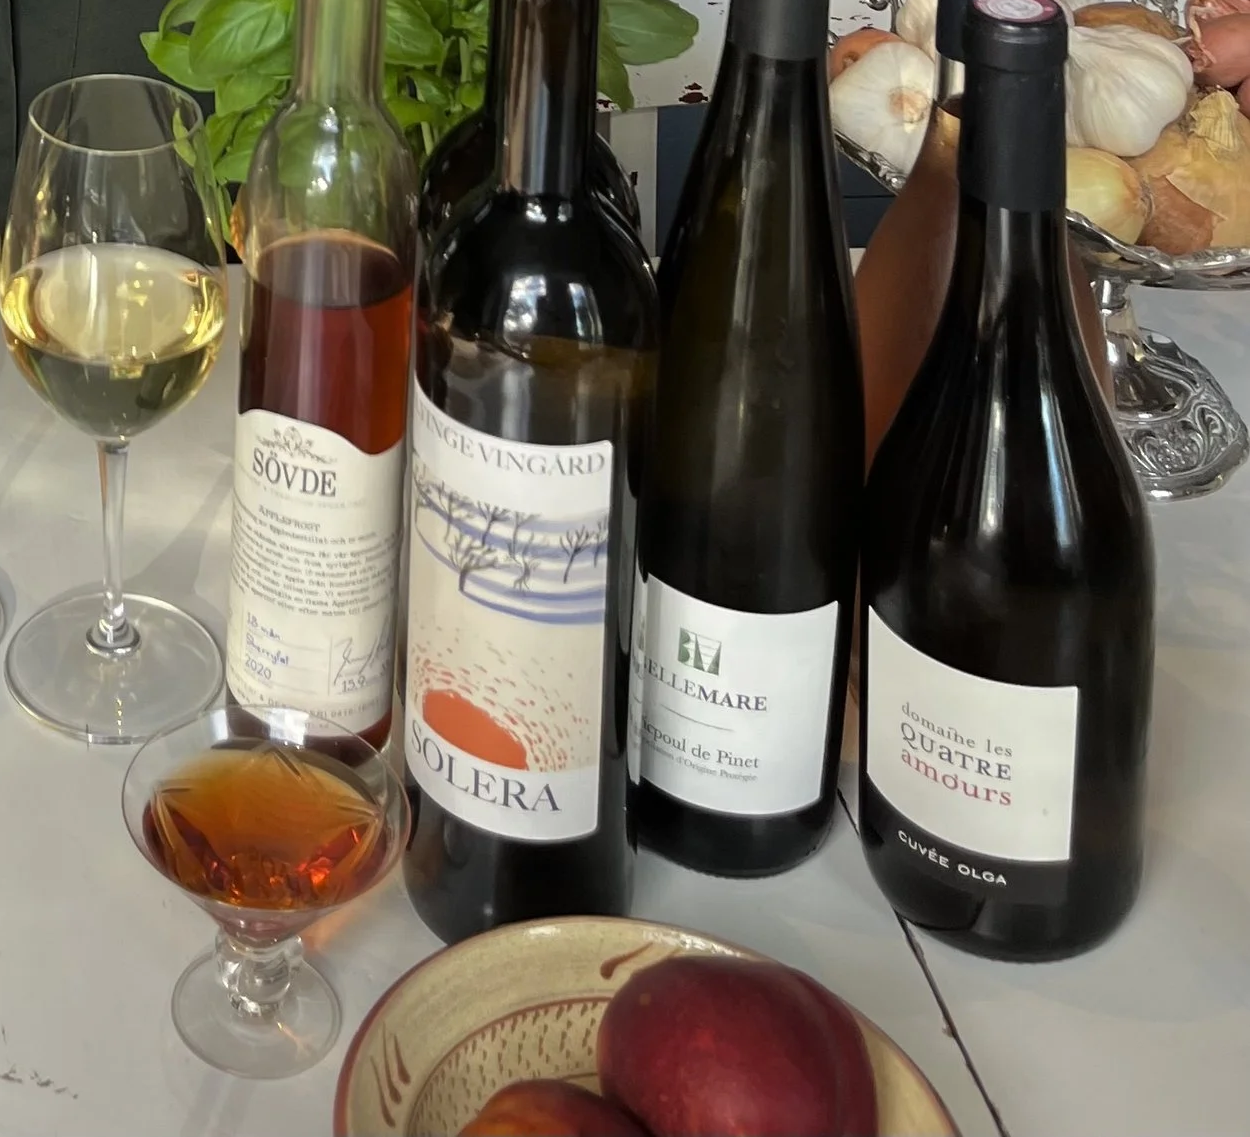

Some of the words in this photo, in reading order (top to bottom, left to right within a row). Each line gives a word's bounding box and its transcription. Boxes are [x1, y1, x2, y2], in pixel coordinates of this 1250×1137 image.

[252, 447, 337, 497] SÖVDE
[244, 653, 272, 680] 2020
[641, 715, 686, 753] icpoul
[691, 743, 711, 761] de
[716, 748, 759, 769] Pinet
[900, 701, 976, 749] domaine
[985, 738, 1013, 758] les
[411, 719, 562, 812] SOLERA
[900, 748, 1012, 806] amours
[897, 829, 950, 868] CUVÉE
[957, 863, 1008, 887] OLGA
